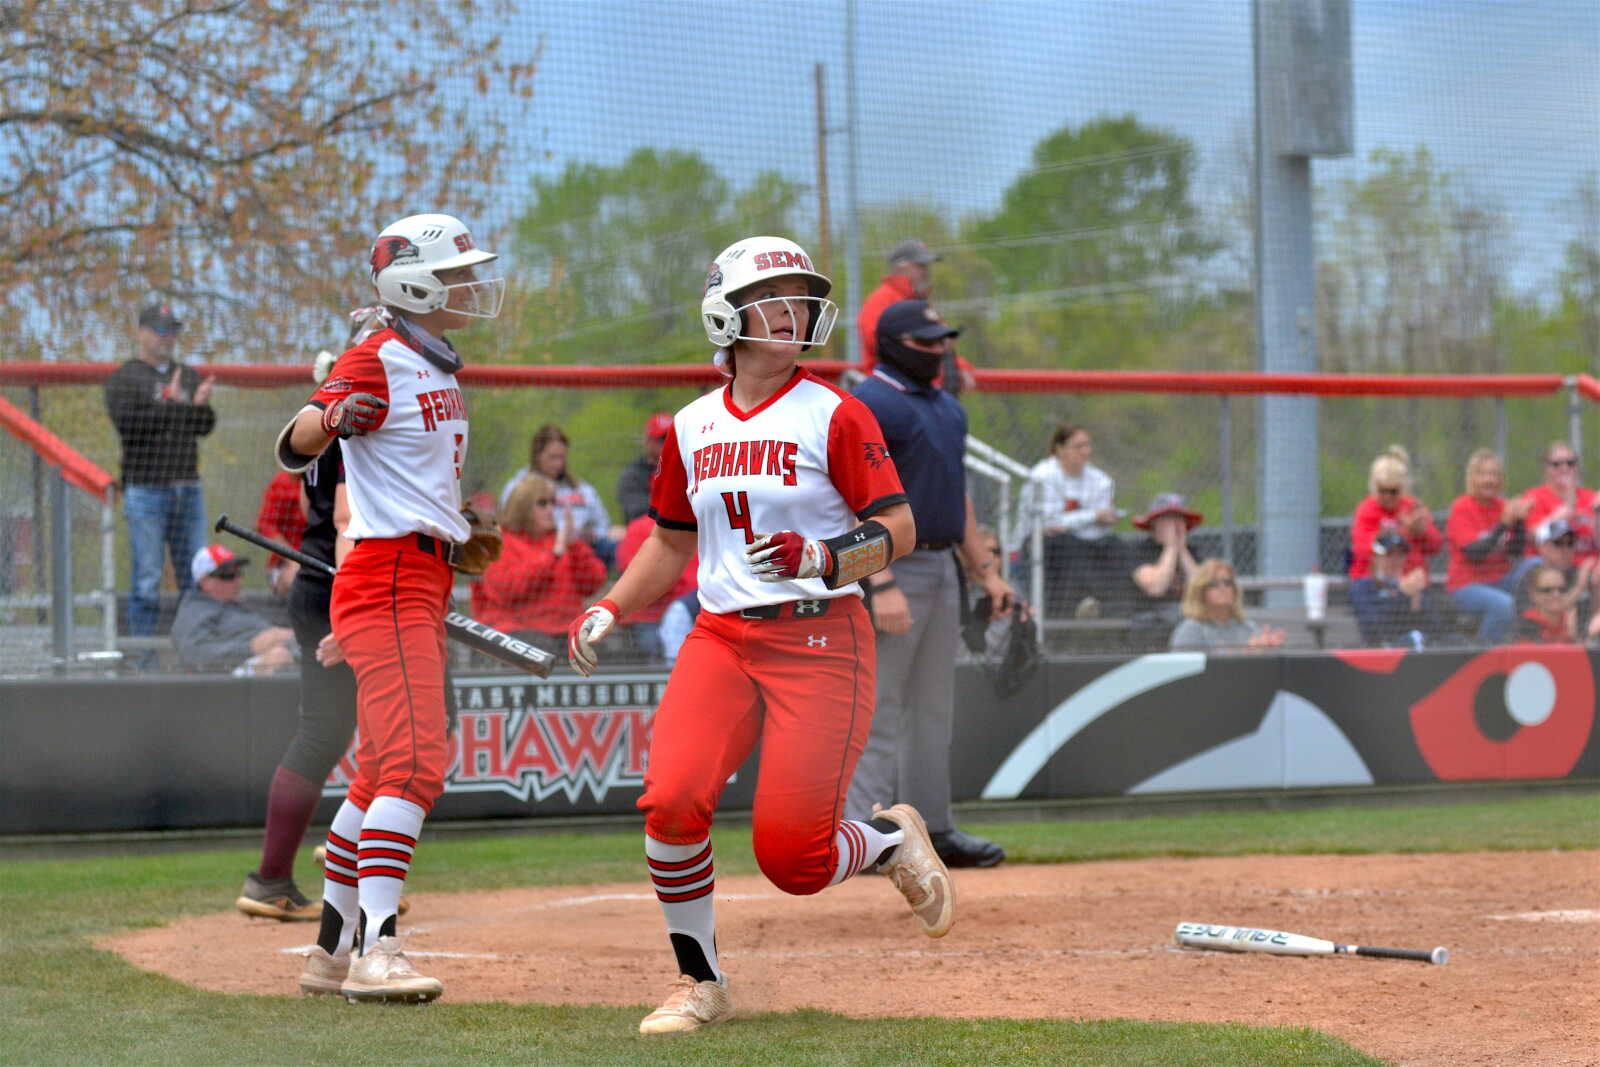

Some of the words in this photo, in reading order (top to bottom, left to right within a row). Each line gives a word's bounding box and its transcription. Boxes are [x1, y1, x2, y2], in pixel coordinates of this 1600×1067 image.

[691, 440, 799, 495] REDHAWKS
[720, 491, 755, 545] 4
[445, 611, 556, 663] WLINGS
